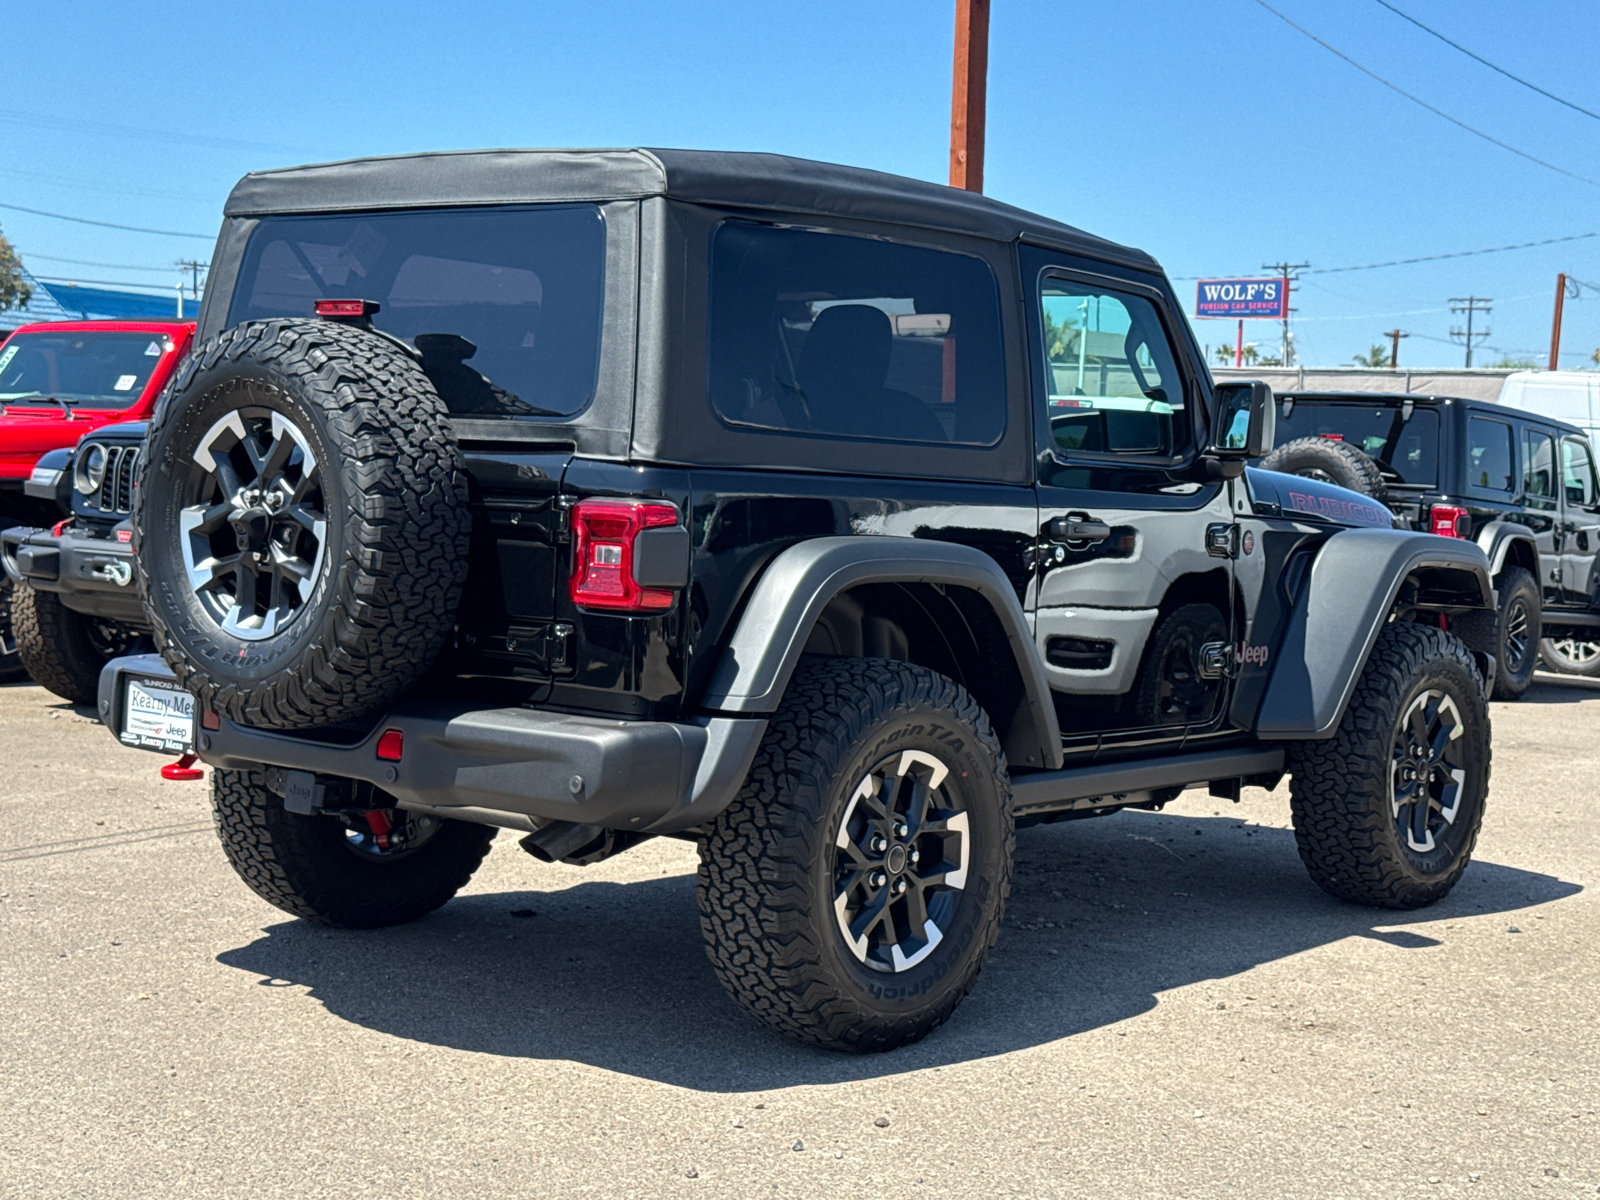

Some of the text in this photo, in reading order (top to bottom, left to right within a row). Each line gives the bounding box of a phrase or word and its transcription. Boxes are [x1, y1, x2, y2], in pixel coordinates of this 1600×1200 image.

[1204, 283, 1276, 301] WOLF'S
[1231, 302, 1245, 310] CAR
[1248, 302, 1278, 310] SERVICE
[1289, 492, 1392, 528] RUBICON
[1236, 640, 1269, 667] Jeep
[131, 690, 170, 717] Kearny
[166, 723, 187, 739] Jeep
[926, 723, 966, 755] T/A
[868, 875, 990, 1001] BFGoodrich
